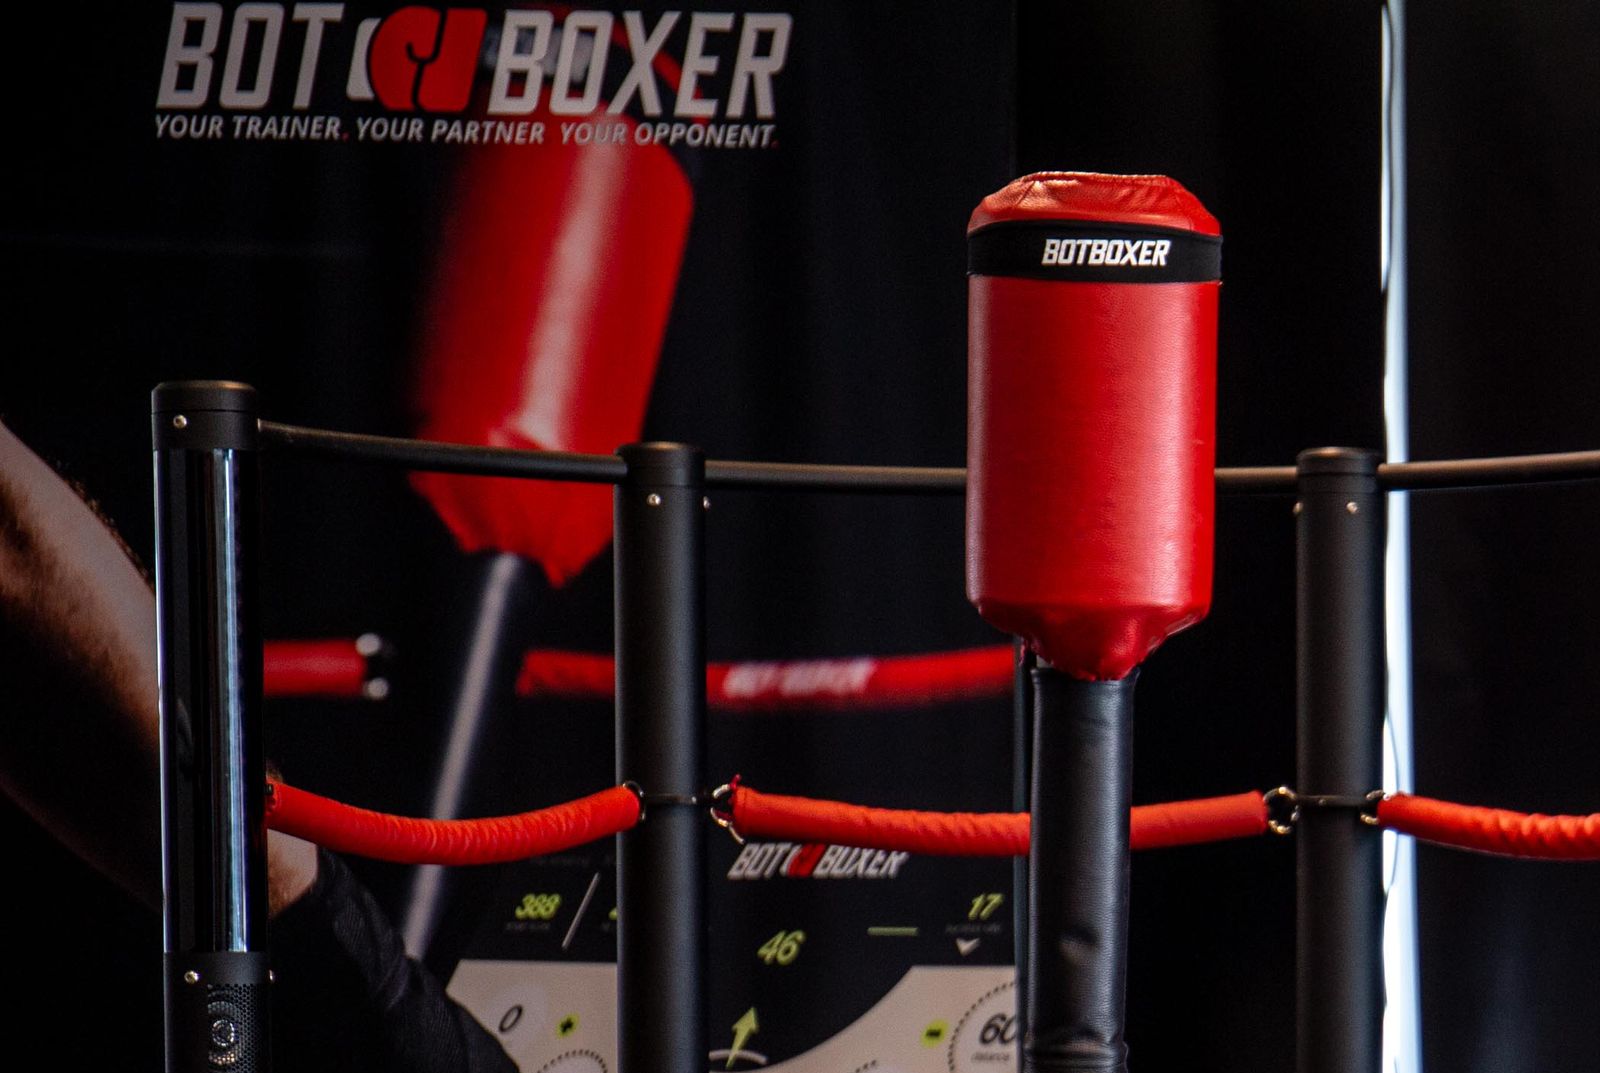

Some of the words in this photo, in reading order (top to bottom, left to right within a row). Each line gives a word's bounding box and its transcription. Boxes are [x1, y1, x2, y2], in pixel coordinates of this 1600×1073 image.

[156, 2, 345, 109] BOT
[487, 9, 793, 118] BOXER
[155, 115, 223, 139] YOUR
[356, 117, 429, 141] YOUR
[560, 122, 627, 144] YOUR
[1041, 238, 1171, 266] BOTBOXER
[727, 843, 791, 880] BOT
[968, 892, 1004, 920] 17
[757, 930, 805, 965] 46
[499, 1006, 522, 1032] 0
